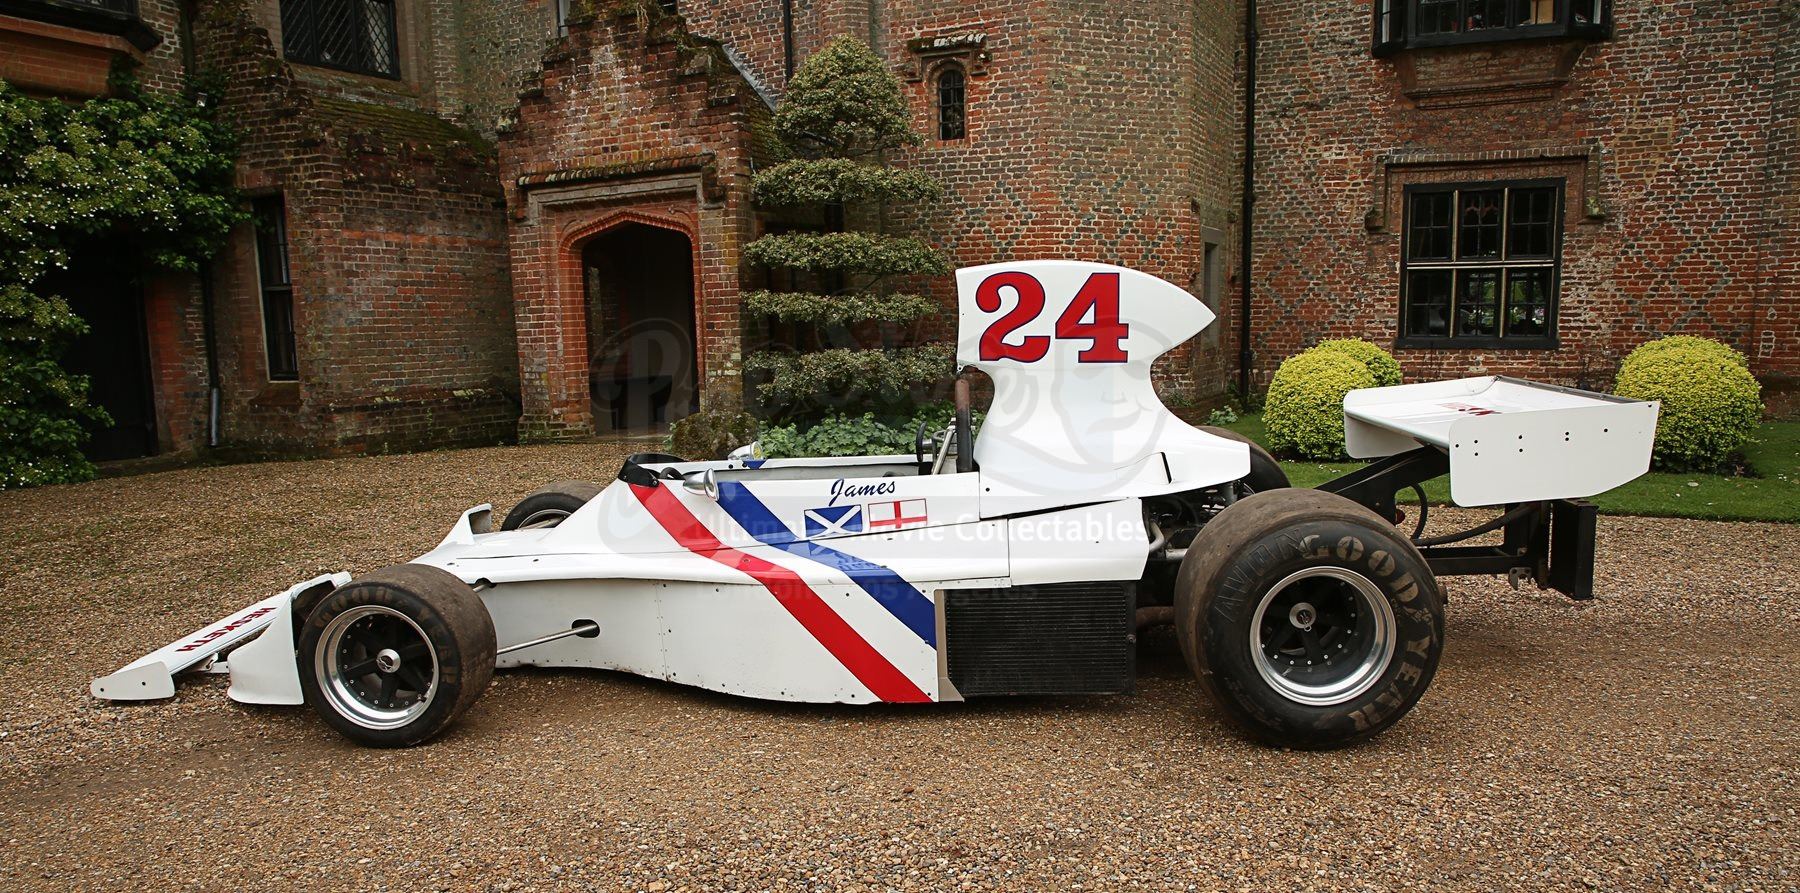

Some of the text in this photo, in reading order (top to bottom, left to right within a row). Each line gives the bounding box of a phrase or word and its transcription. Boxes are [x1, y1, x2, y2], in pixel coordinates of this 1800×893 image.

[976, 271, 1129, 363] 24
[828, 478, 896, 506] James
[174, 606, 278, 652] HESKETH
